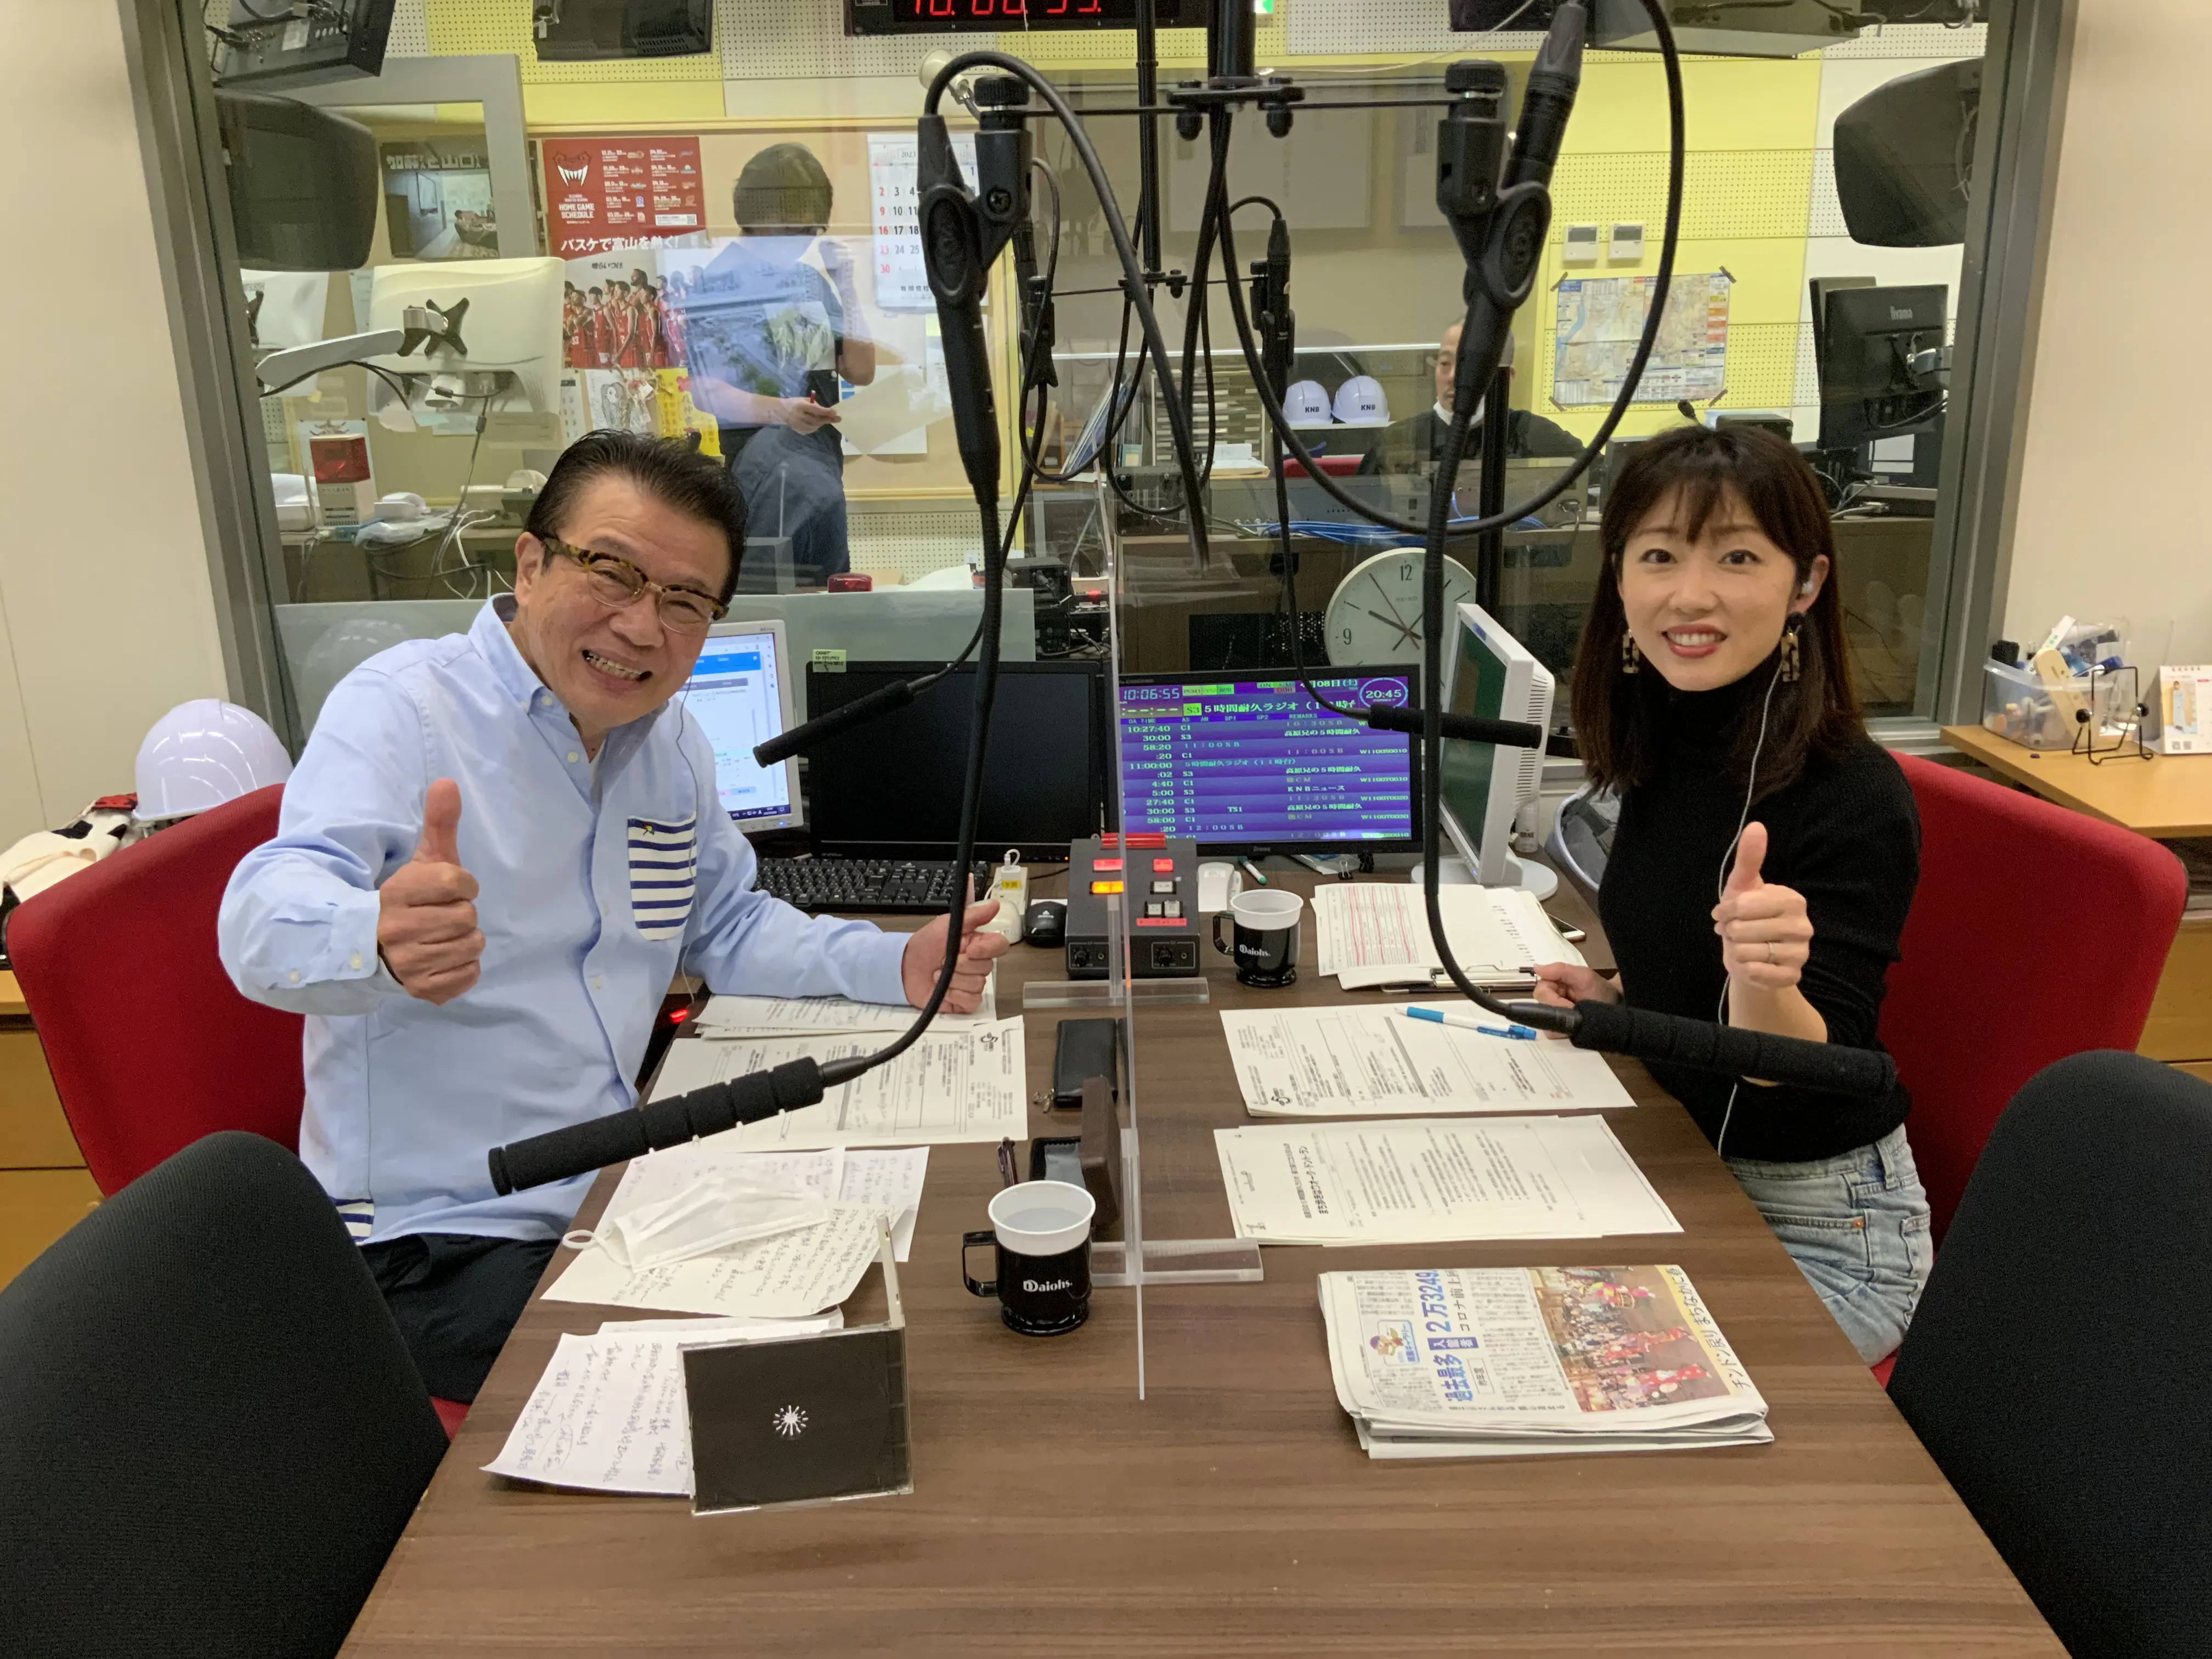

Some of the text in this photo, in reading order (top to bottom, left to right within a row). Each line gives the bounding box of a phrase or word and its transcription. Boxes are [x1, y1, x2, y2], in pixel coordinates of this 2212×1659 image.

[970, 166, 974, 176] 1
[879, 187, 915, 196] 2 3 4
[558, 202, 595, 211] HOME GAME
[879, 206, 917, 216] 9 10 11
[879, 225, 919, 235] 16 17 18
[880, 245, 919, 254] 23 24 25
[881, 264, 890, 273] 30
[1400, 564, 1412, 581] 12
[1343, 628, 1352, 645] 9
[1124, 688, 1180, 701] 10:06:55
[1365, 689, 1402, 699] 20:45
[1127, 725, 1171, 733] 10:27:40
[1432, 1353, 1474, 1402] 過去最多
